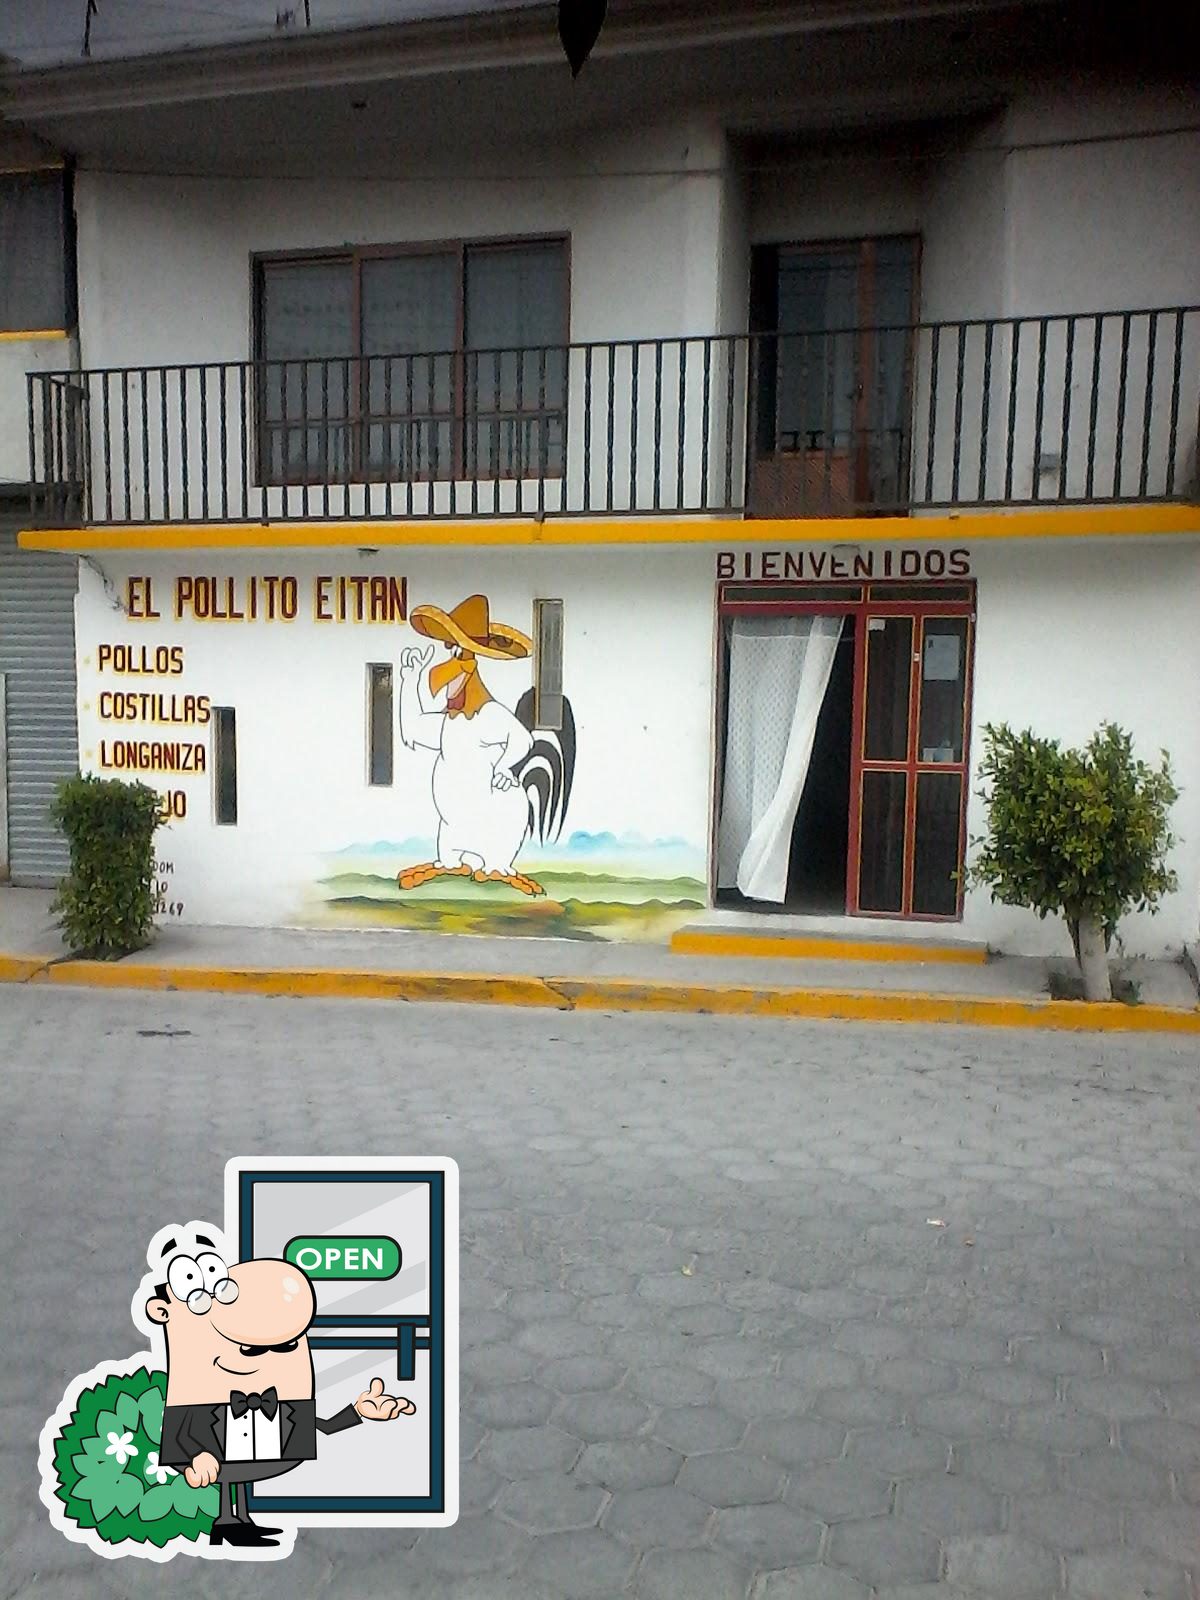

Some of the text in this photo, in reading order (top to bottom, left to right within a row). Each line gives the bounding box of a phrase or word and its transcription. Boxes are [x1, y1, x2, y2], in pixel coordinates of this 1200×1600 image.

[716, 549, 971, 579] BIENVENIDOS
[127, 576, 408, 623] EL POLLITO EITAN
[98, 644, 184, 676] POLLOS
[99, 691, 211, 725] COSTILLAS
[100, 740, 206, 774] LONGANIZA
